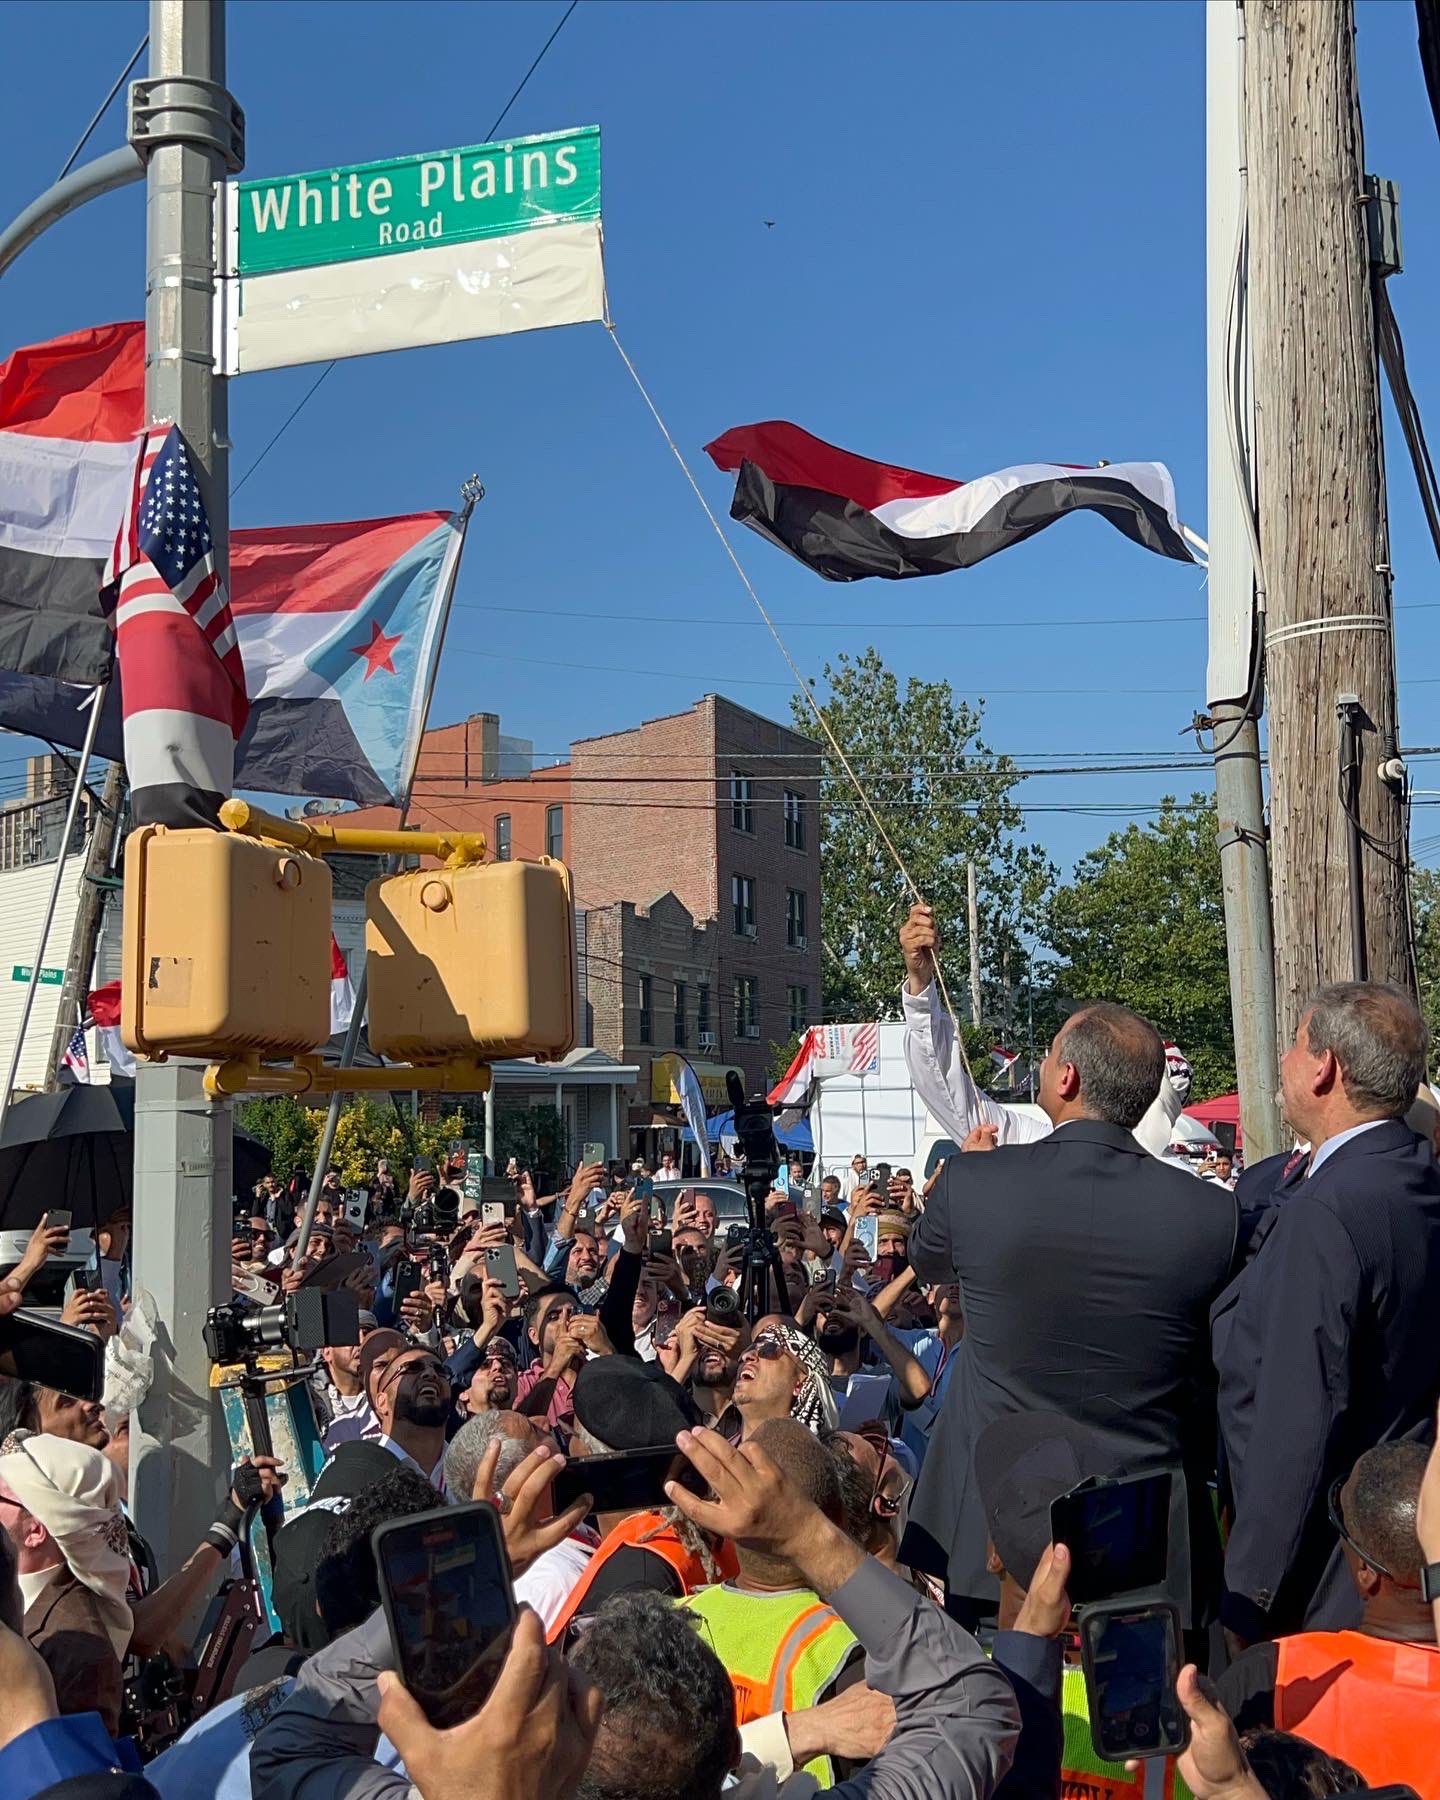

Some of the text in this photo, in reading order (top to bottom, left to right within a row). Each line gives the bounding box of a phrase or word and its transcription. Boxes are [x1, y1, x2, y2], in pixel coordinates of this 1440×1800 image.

[250, 143, 578, 233] White Plains
[379, 211, 443, 246] Road
